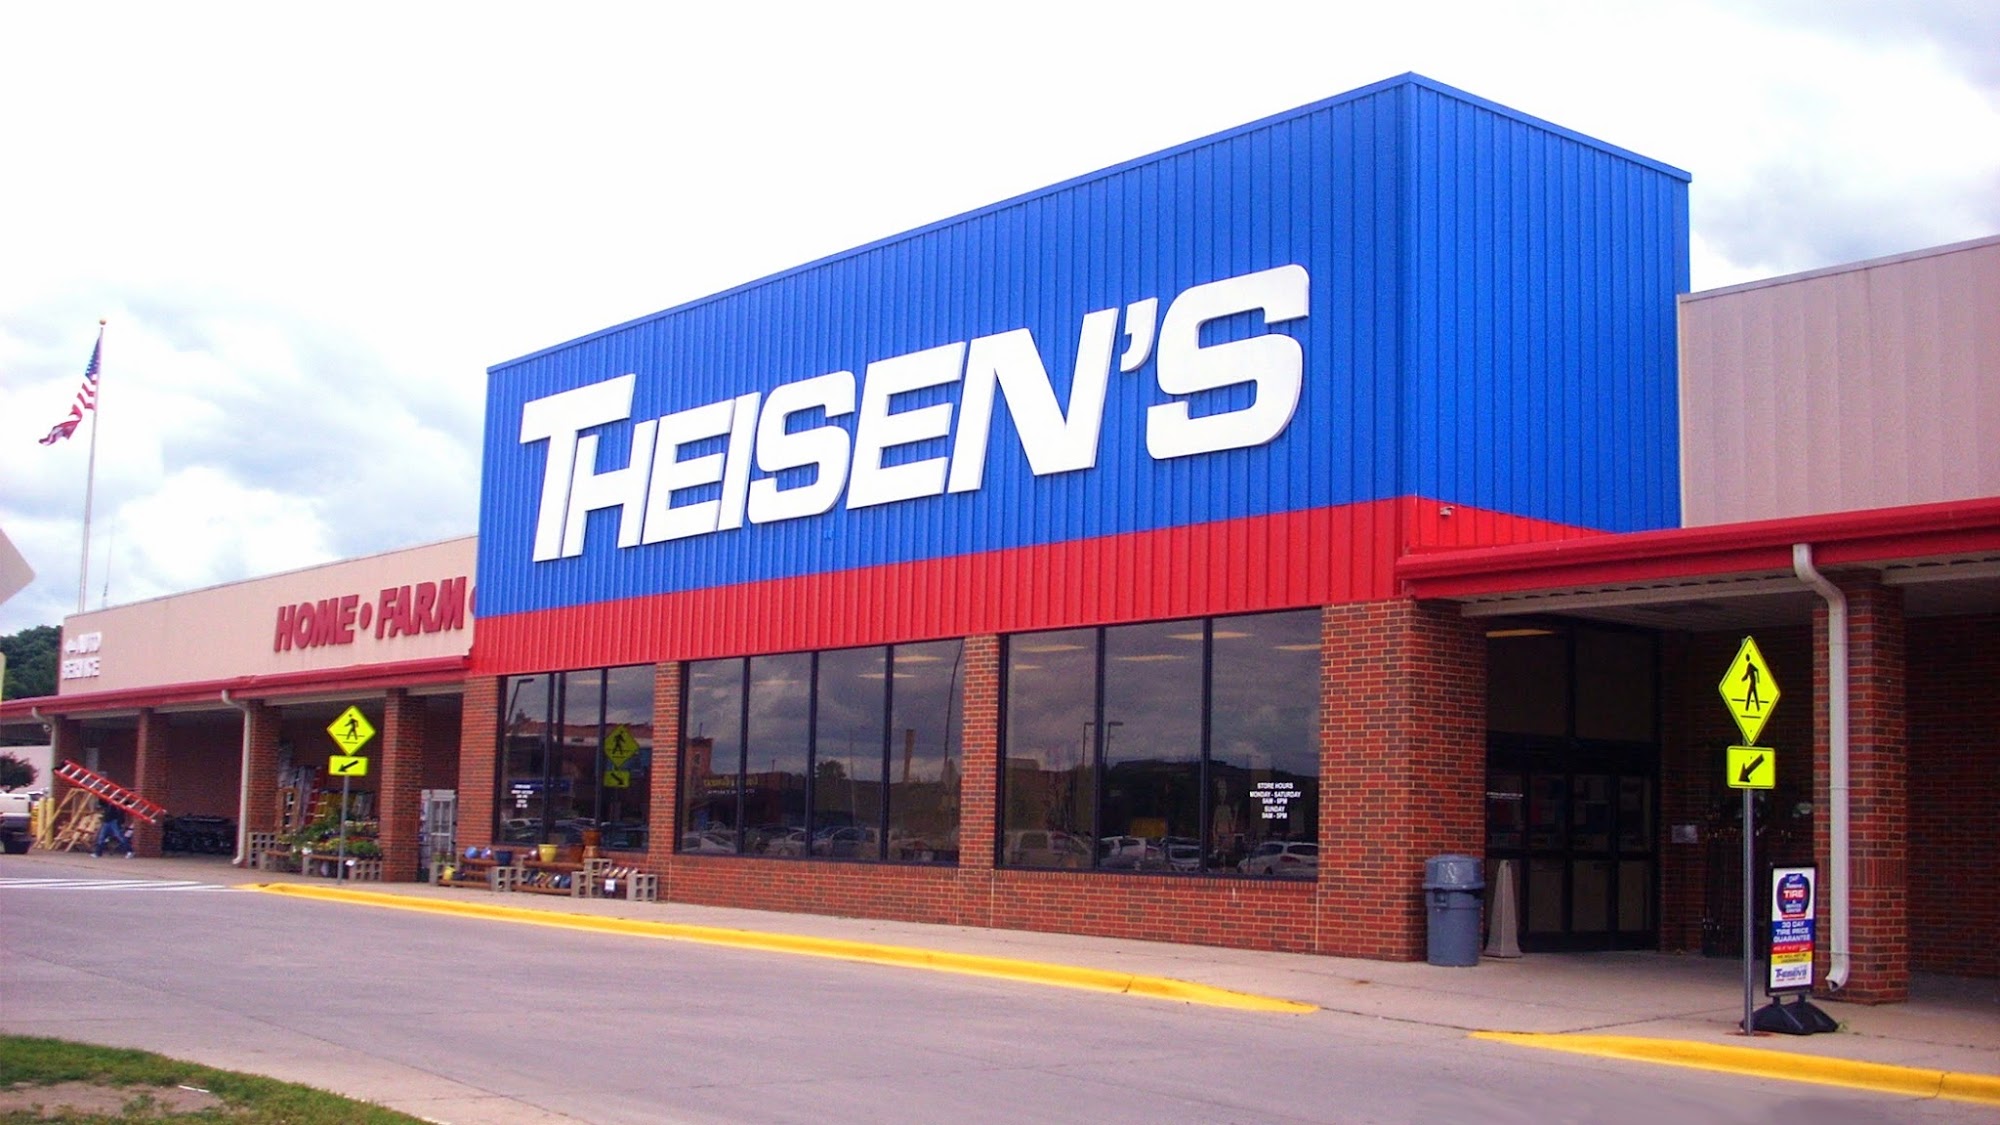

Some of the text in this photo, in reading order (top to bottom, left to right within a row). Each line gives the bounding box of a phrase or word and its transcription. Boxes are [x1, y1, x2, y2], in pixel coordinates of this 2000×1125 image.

[519, 263, 1310, 562] THEISEN'S
[274, 576, 466, 652] HOME FARM
[77, 632, 102, 654] AUTO
[63, 657, 101, 678] SERVICE
[1783, 889, 1804, 899] TIRE
[1792, 920, 1805, 928] DAY
[1773, 934, 1811, 943] GUARANTEE
